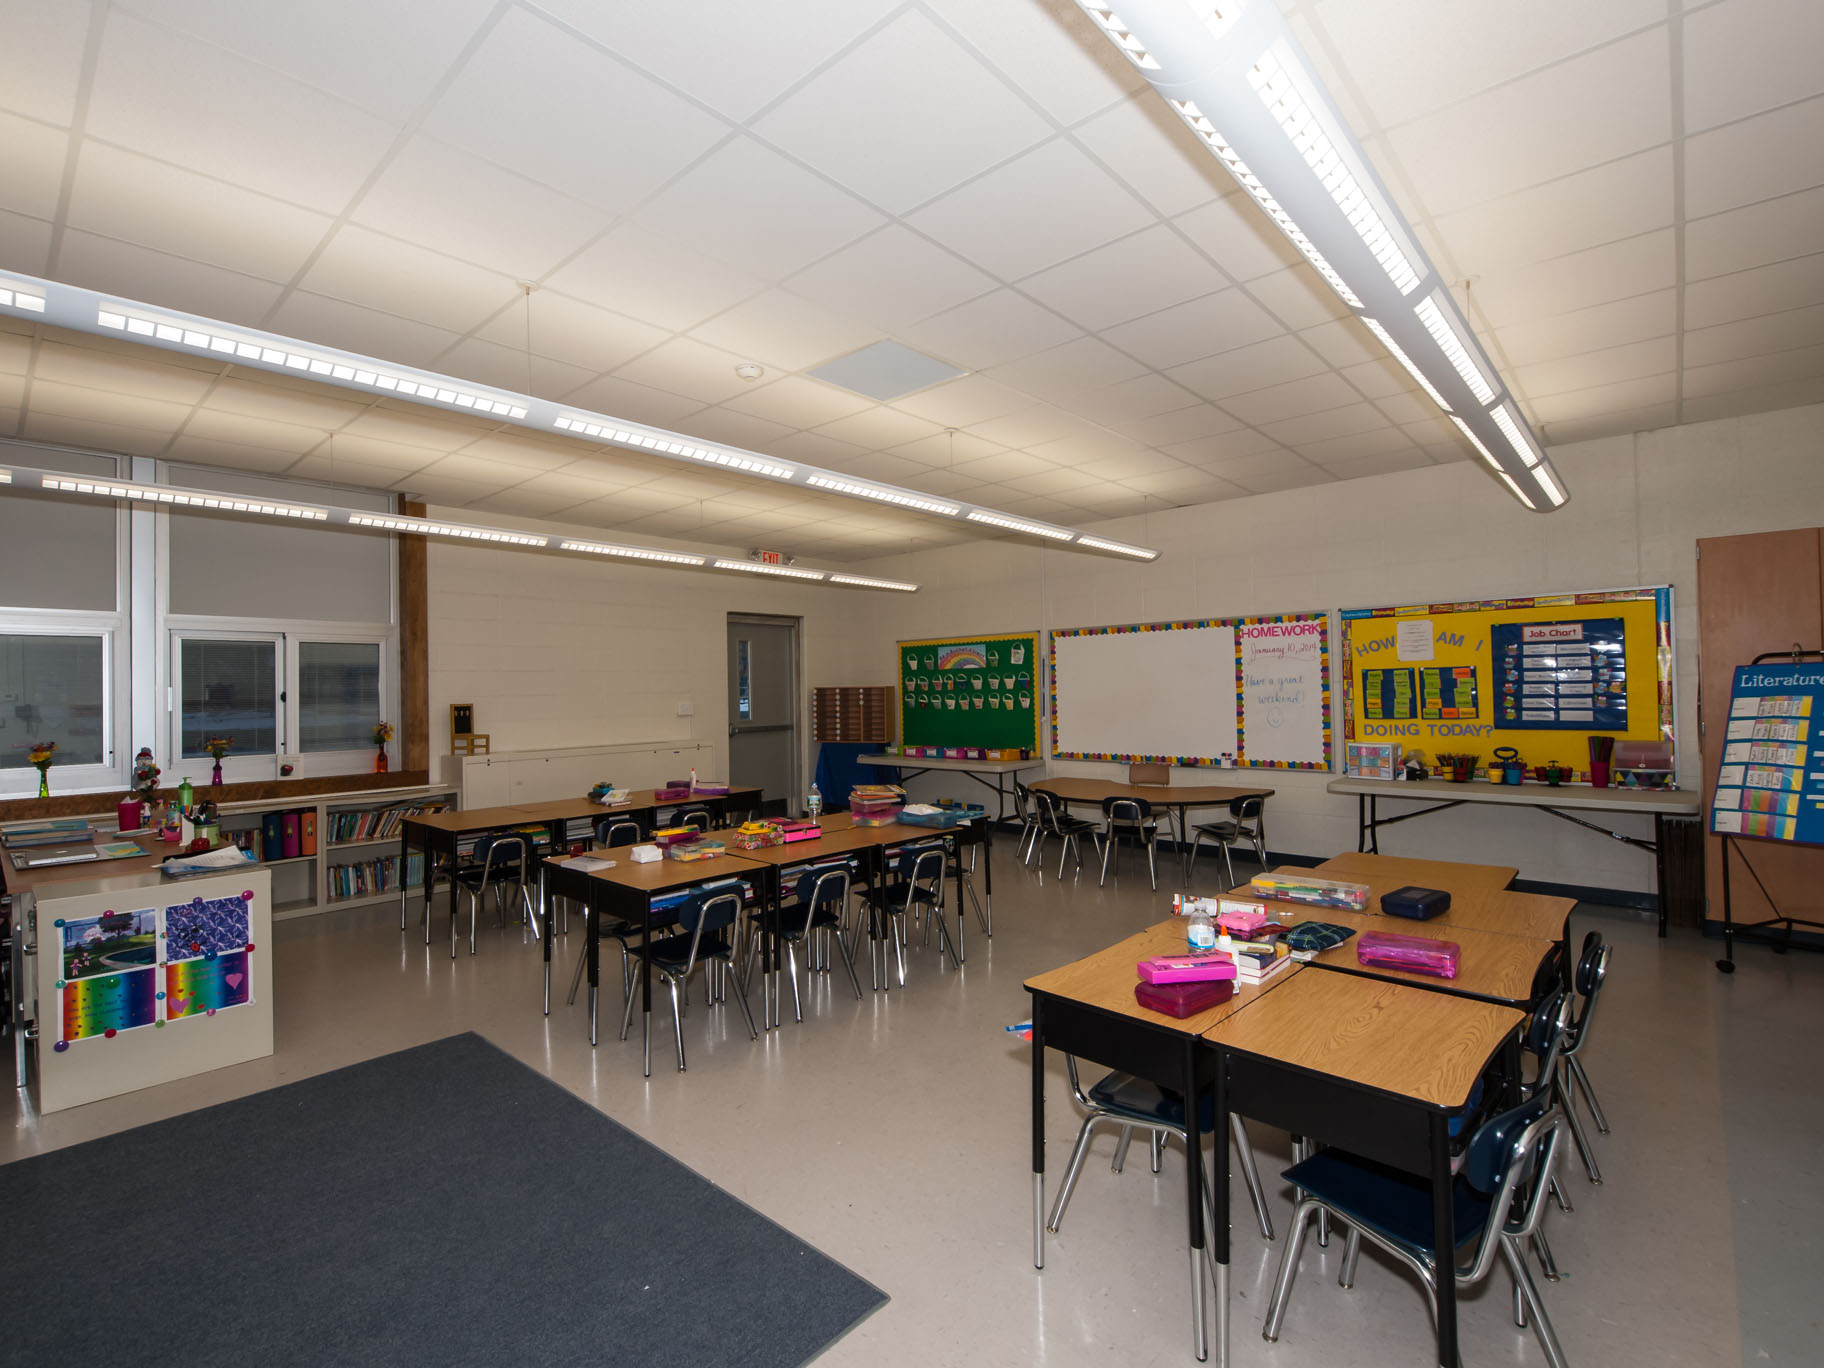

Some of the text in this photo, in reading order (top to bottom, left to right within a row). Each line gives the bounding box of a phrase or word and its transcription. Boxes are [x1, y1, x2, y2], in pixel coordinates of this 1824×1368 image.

[762, 551, 780, 565] EXIT
[1241, 623, 1320, 638] HOMEWORK
[1528, 628, 1577, 638] Job Chart
[1355, 635, 1395, 657] HOW
[1436, 631, 1464, 647] AM
[1475, 639, 1483, 651] I
[1250, 642, 1285, 662] January
[1245, 674, 1265, 688] Have
[1277, 675, 1304, 691] great
[1740, 673, 1824, 688] Literature
[1364, 723, 1494, 738] DOING TODAY?
